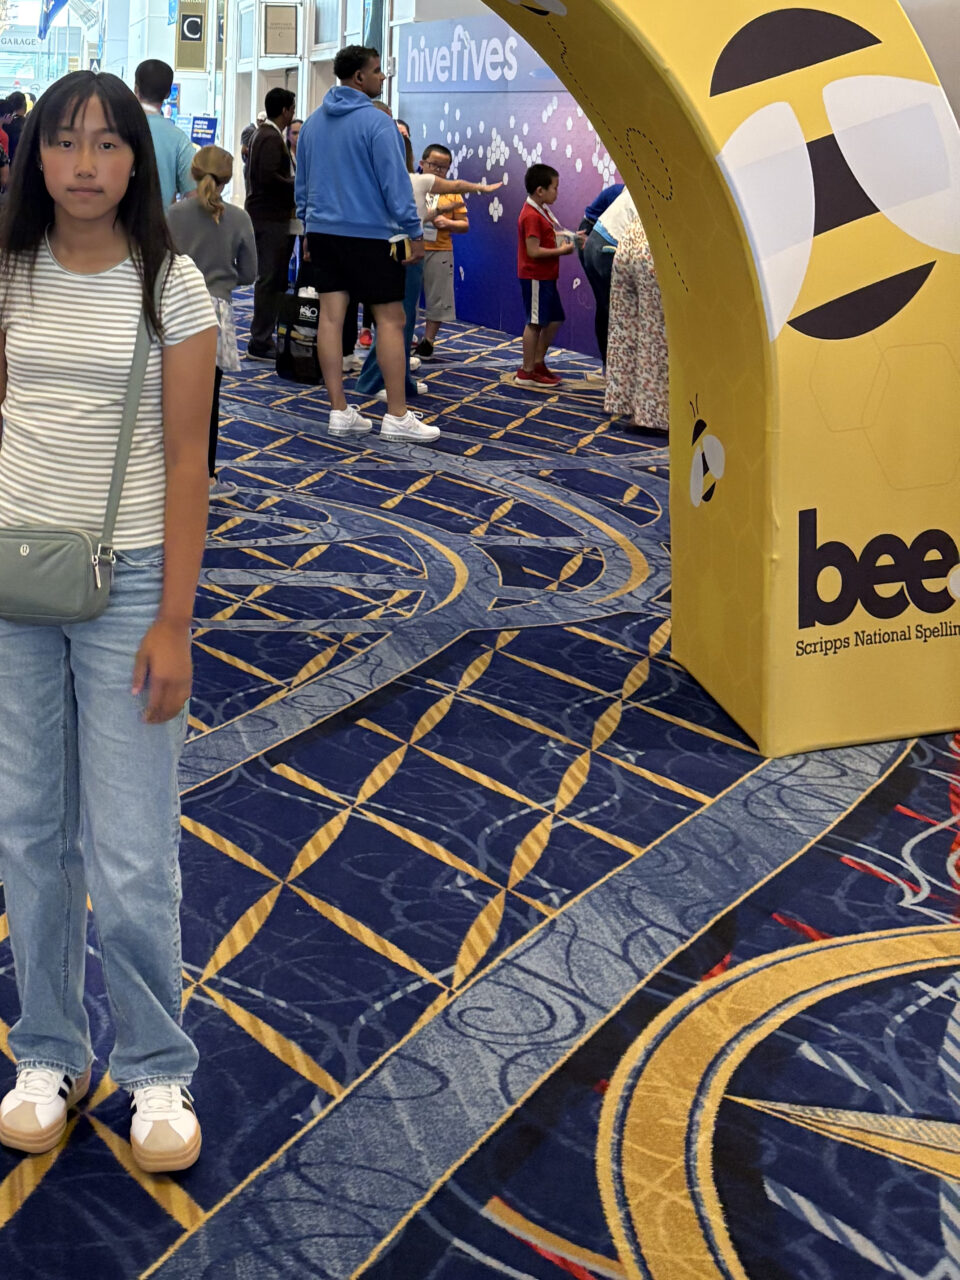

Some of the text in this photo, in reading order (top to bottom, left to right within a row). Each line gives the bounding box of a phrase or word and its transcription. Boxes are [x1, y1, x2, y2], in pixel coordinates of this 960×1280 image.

[0, 37, 37, 46] GARAGE
[183, 17, 201, 39] C
[406, 24, 518, 82] hivefives
[798, 508, 960, 630] bee
[795, 621, 960, 657] Scripps National Spellin
